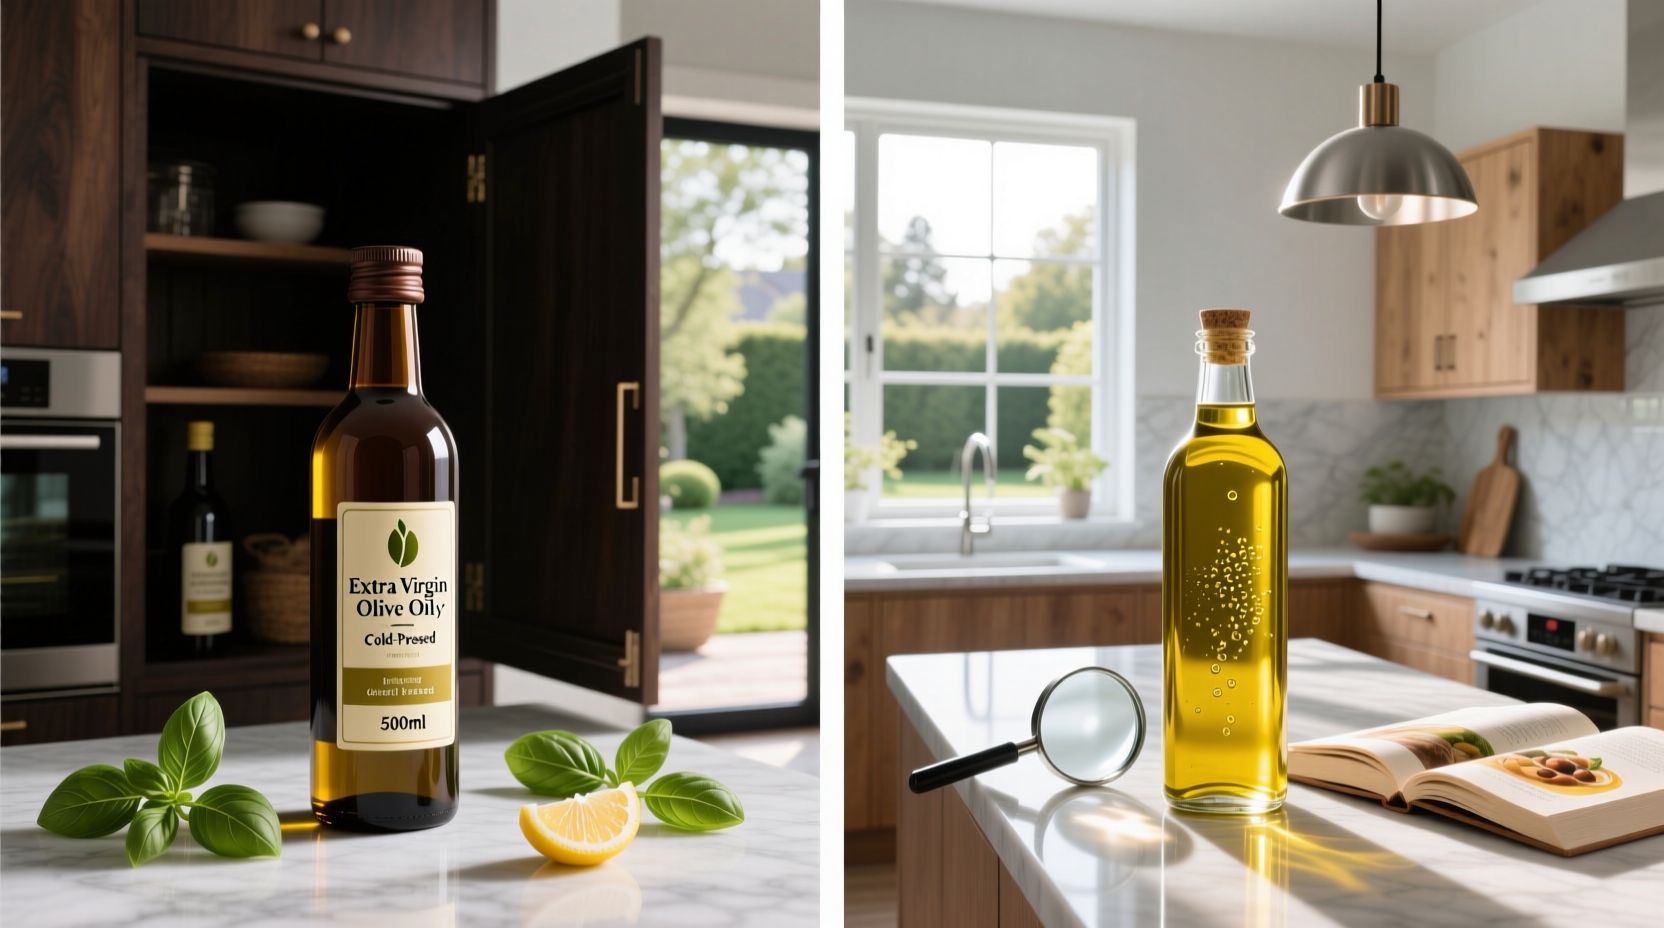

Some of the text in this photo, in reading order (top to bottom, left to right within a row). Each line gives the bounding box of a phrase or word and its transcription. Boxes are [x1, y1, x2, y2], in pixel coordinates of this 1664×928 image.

[349, 576, 447, 598] Extra Virgin
[356, 599, 404, 617] Olive
[380, 714, 426, 731] 500ml
